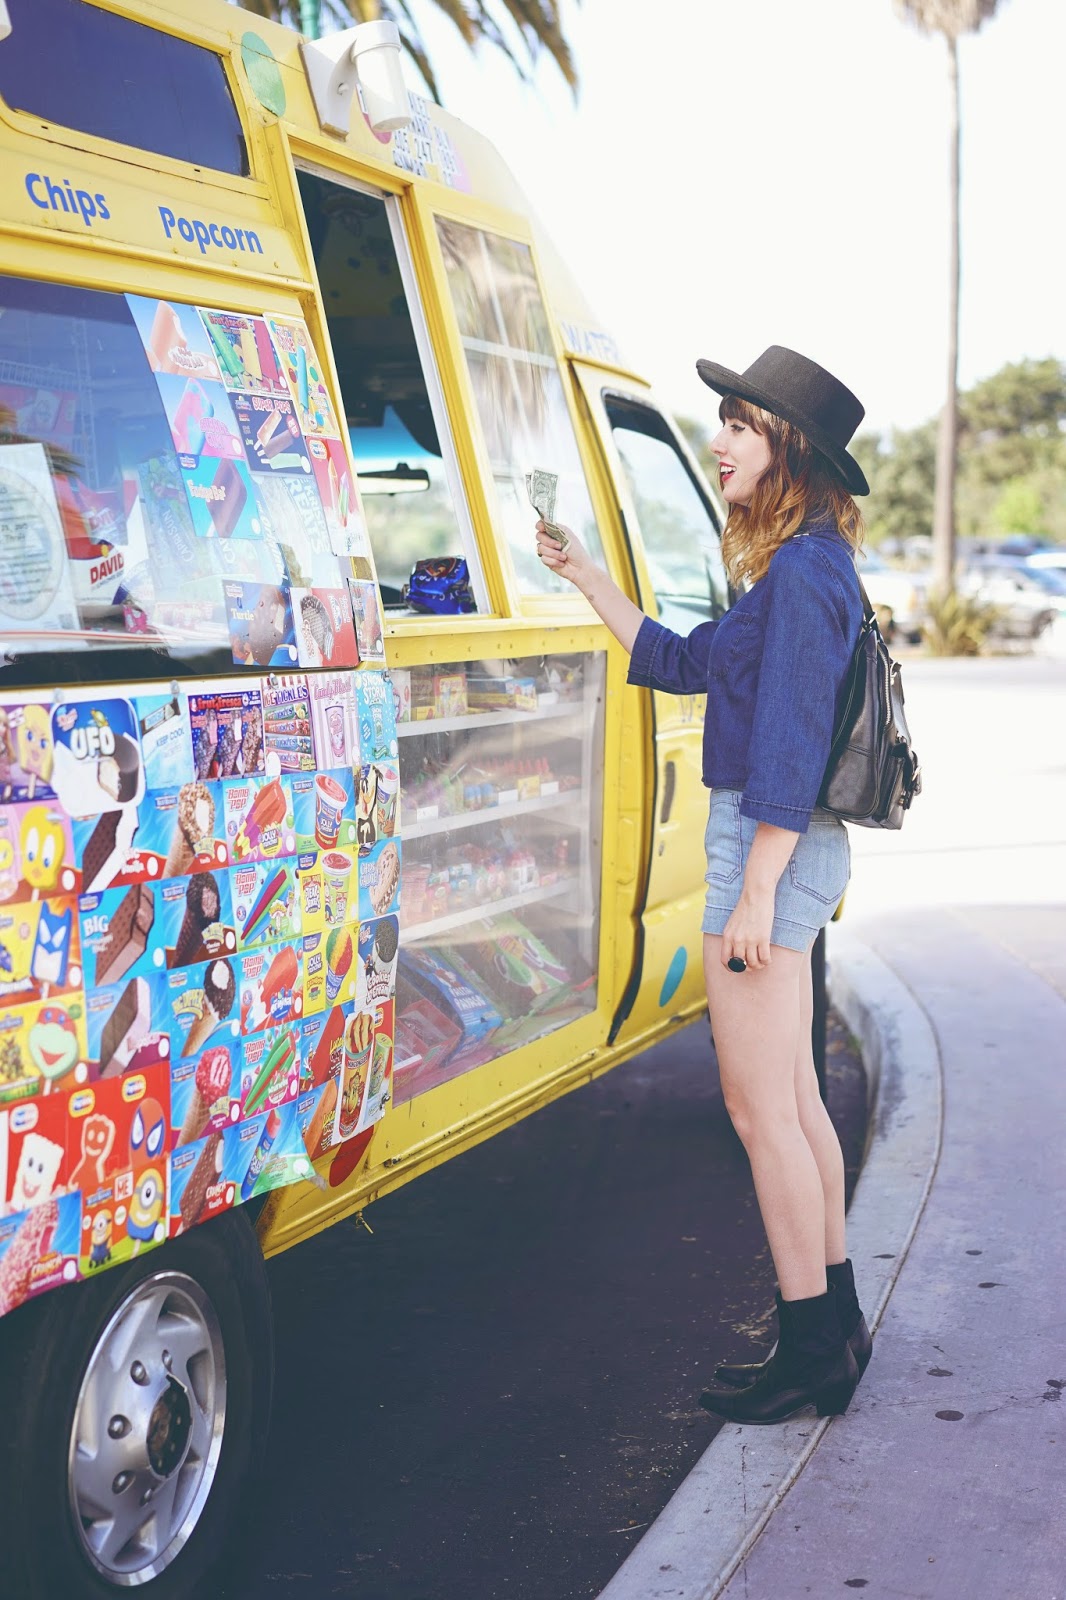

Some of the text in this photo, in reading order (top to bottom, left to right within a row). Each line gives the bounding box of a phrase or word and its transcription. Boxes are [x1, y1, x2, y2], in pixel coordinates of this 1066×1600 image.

[25, 173, 264, 254] Chips Popcorn
[251, 397, 274, 412] SUPER
[274, 398, 292, 415] POPS
[288, 478, 324, 555] REATS
[90, 552, 125, 585] DAVID
[230, 608, 256, 622] Turtle
[314, 681, 335, 701] Candy
[362, 686, 387, 705] STORM
[71, 726, 116, 759] UFO
[156, 728, 186, 747] KEEP COOL
[226, 788, 249, 800] BOMB
[228, 798, 248, 811] POP
[261, 829, 277, 842] JOLLY
[235, 872, 257, 885] BOMB
[236, 883, 254, 897] POP
[83, 914, 109, 936] BIG
[242, 955, 264, 969] BOMB
[244, 966, 262, 981] POP
[117, 1178, 129, 1198] ME
